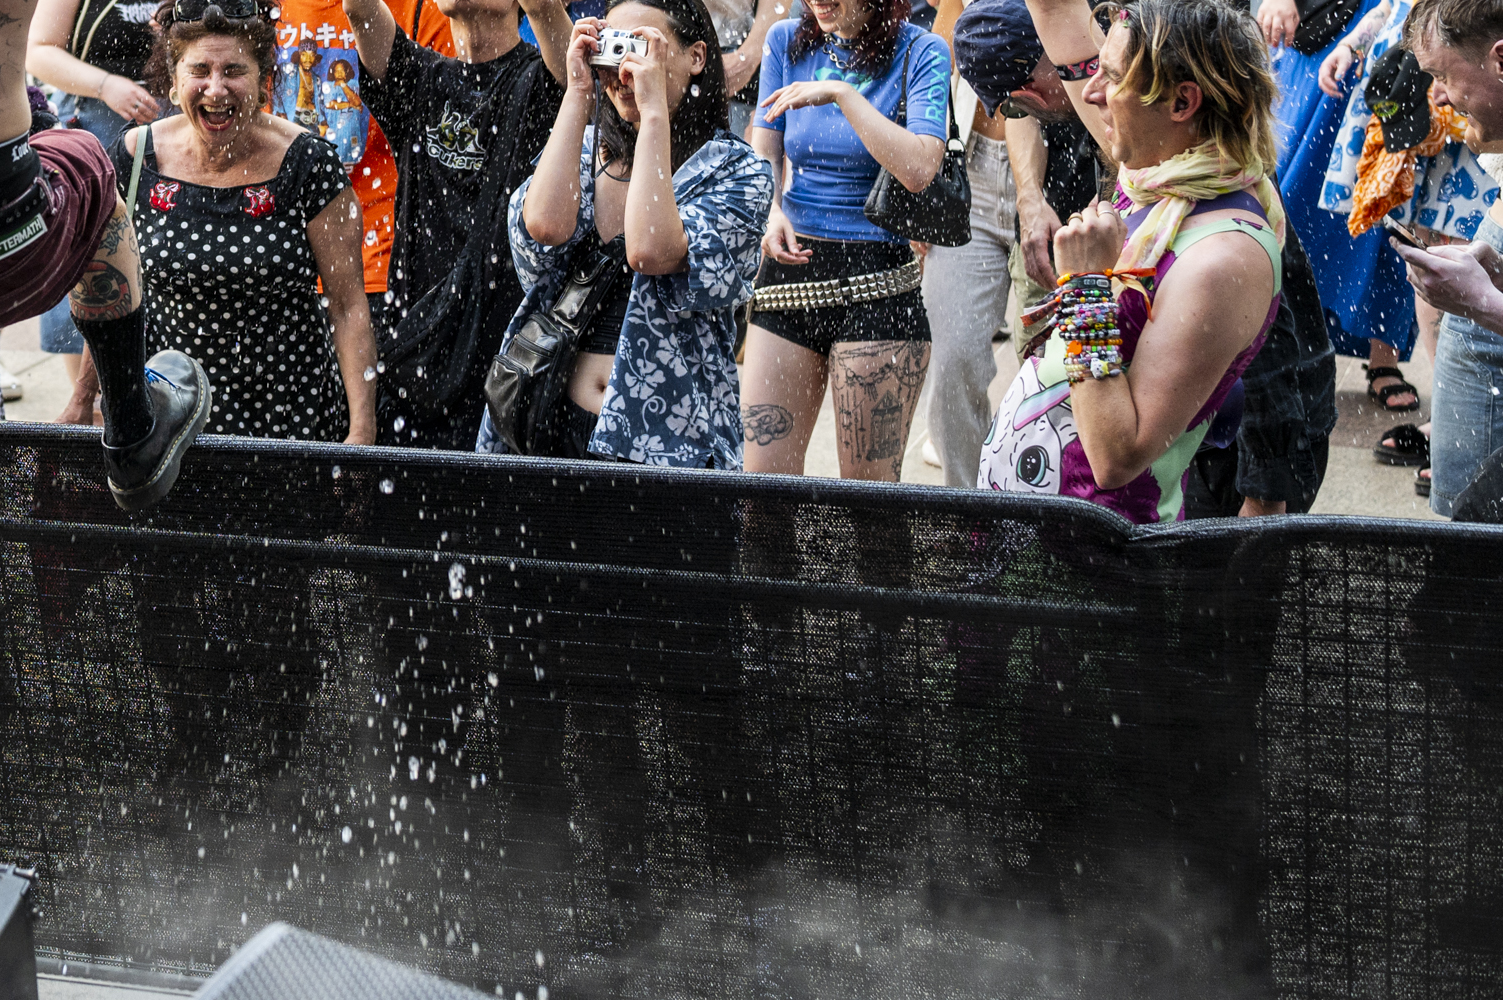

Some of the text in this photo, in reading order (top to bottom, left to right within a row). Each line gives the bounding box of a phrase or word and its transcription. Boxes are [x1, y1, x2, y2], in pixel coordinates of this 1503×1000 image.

[275, 22, 358, 50] ウトキャ
[924, 48, 949, 123] ROXY
